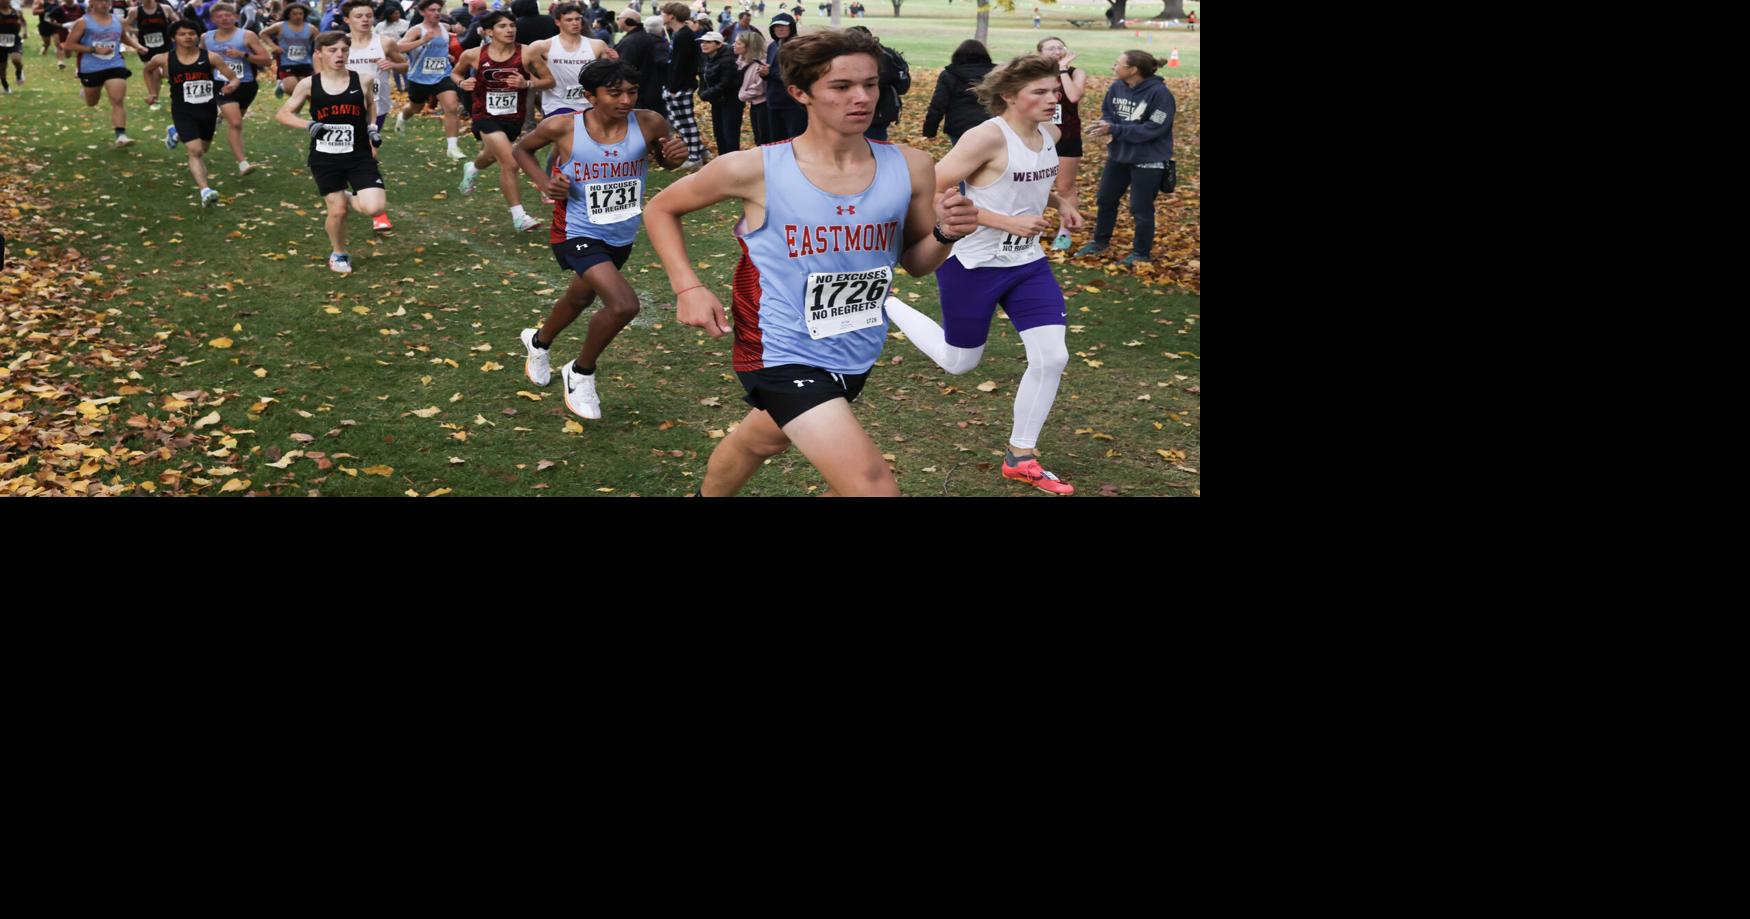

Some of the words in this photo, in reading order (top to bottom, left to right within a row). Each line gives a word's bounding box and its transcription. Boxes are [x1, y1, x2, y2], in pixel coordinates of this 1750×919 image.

[230, 63, 243, 75] 29
[186, 83, 213, 96] 1716
[488, 96, 517, 107] 1757
[317, 107, 330, 120] AC
[331, 104, 361, 117] DAVIS
[321, 130, 353, 142] 723
[574, 159, 646, 182] EASTMONT
[604, 180, 638, 191] EXCUSES
[589, 186, 639, 210] 1731
[785, 221, 899, 258] EASTMONT
[1002, 244, 1013, 252] NO
[815, 274, 833, 284] NO
[836, 270, 888, 282] EXCUSES
[810, 279, 889, 312] 1726
[812, 310, 828, 321] NO
